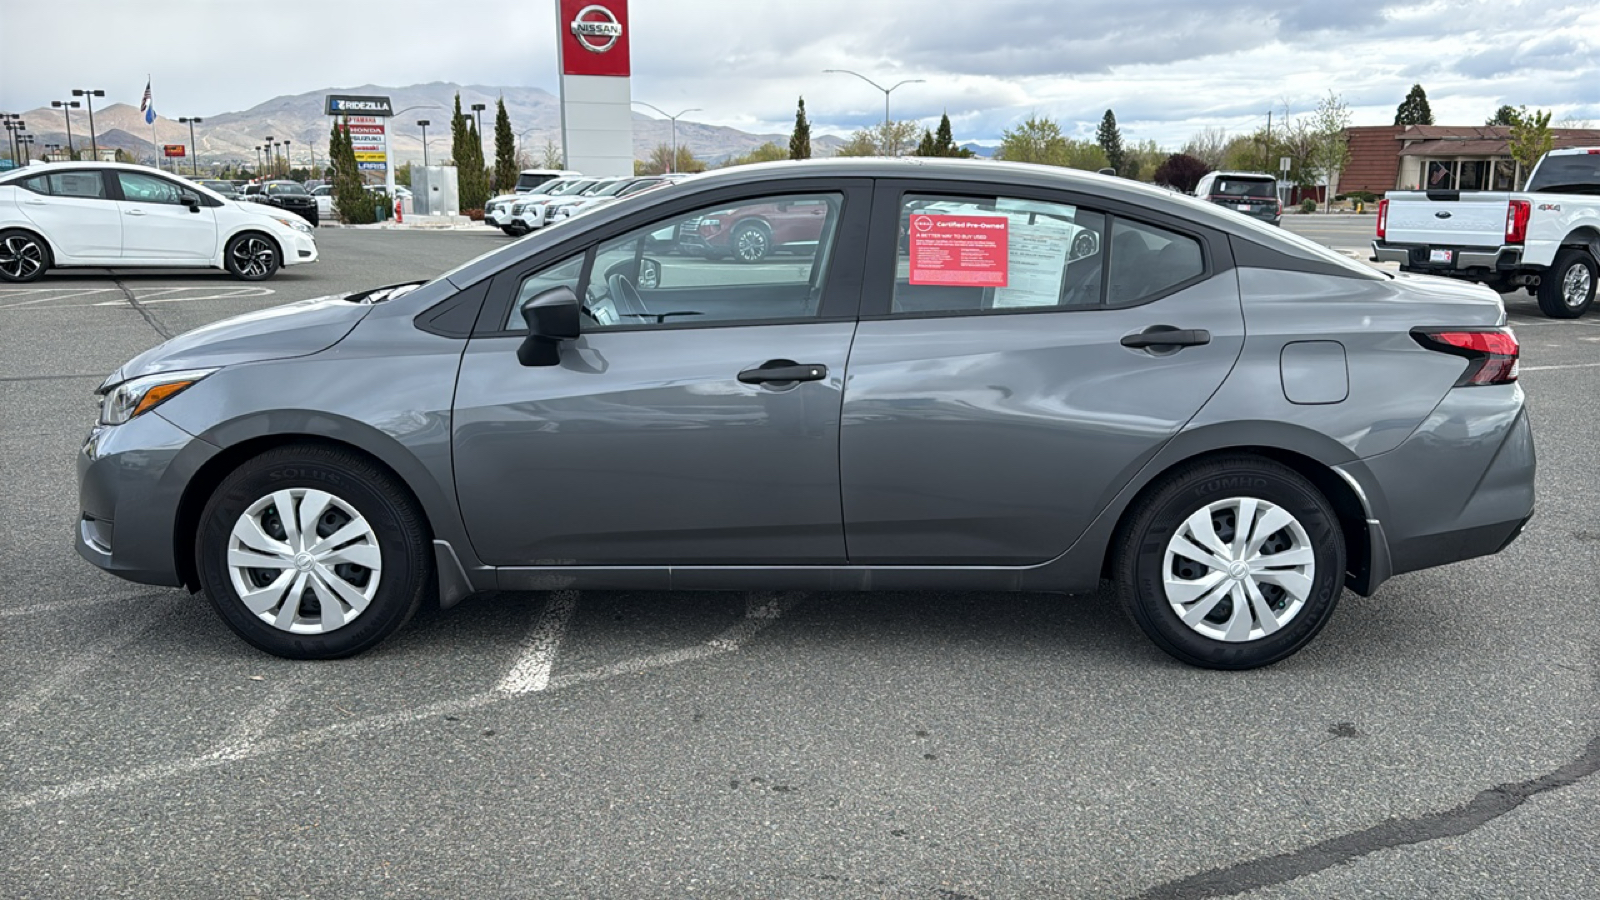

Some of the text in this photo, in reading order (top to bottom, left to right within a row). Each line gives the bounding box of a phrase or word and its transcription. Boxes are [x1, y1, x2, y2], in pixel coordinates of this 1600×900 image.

[577, 24, 617, 33] NISSAN
[345, 100, 390, 110] RIDEZILLA
[936, 220, 965, 228] Certified
[966, 221, 1005, 230] Pre-Owned
[1195, 476, 1267, 495] KUMHO
